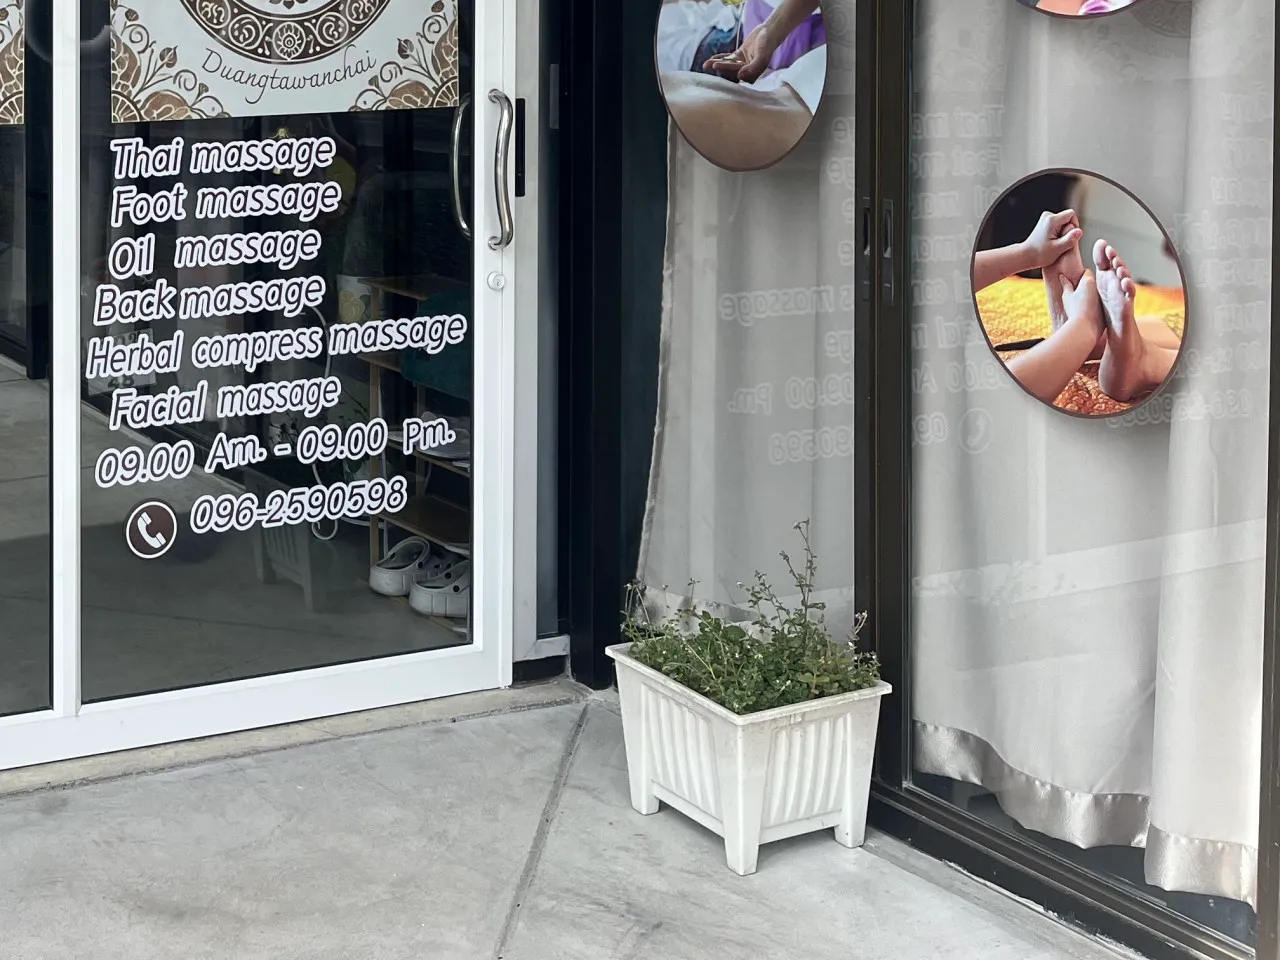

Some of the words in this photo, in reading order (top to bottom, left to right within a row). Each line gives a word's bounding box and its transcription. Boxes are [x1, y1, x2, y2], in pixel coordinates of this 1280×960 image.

[201, 44, 377, 104] Duangtawanchai
[110, 137, 184, 179] Thai
[190, 136, 336, 177] massage
[111, 182, 187, 228] Foot
[195, 182, 342, 222] massage
[109, 233, 155, 280] Oil
[174, 229, 322, 270] massage
[94, 279, 178, 326] Back
[179, 275, 325, 318] massage
[86, 330, 184, 379] Herbal
[192, 324, 323, 372] compress
[328, 314, 467, 354] massage
[109, 381, 207, 431] Facial
[217, 376, 342, 418] massage
[95, 440, 195, 489] 09.00
[204, 432, 268, 474] Am.
[273, 441, 292, 456] -
[296, 418, 388, 465] 09.00
[403, 417, 456, 454] Pm.
[190, 475, 408, 534] 096-2590598
